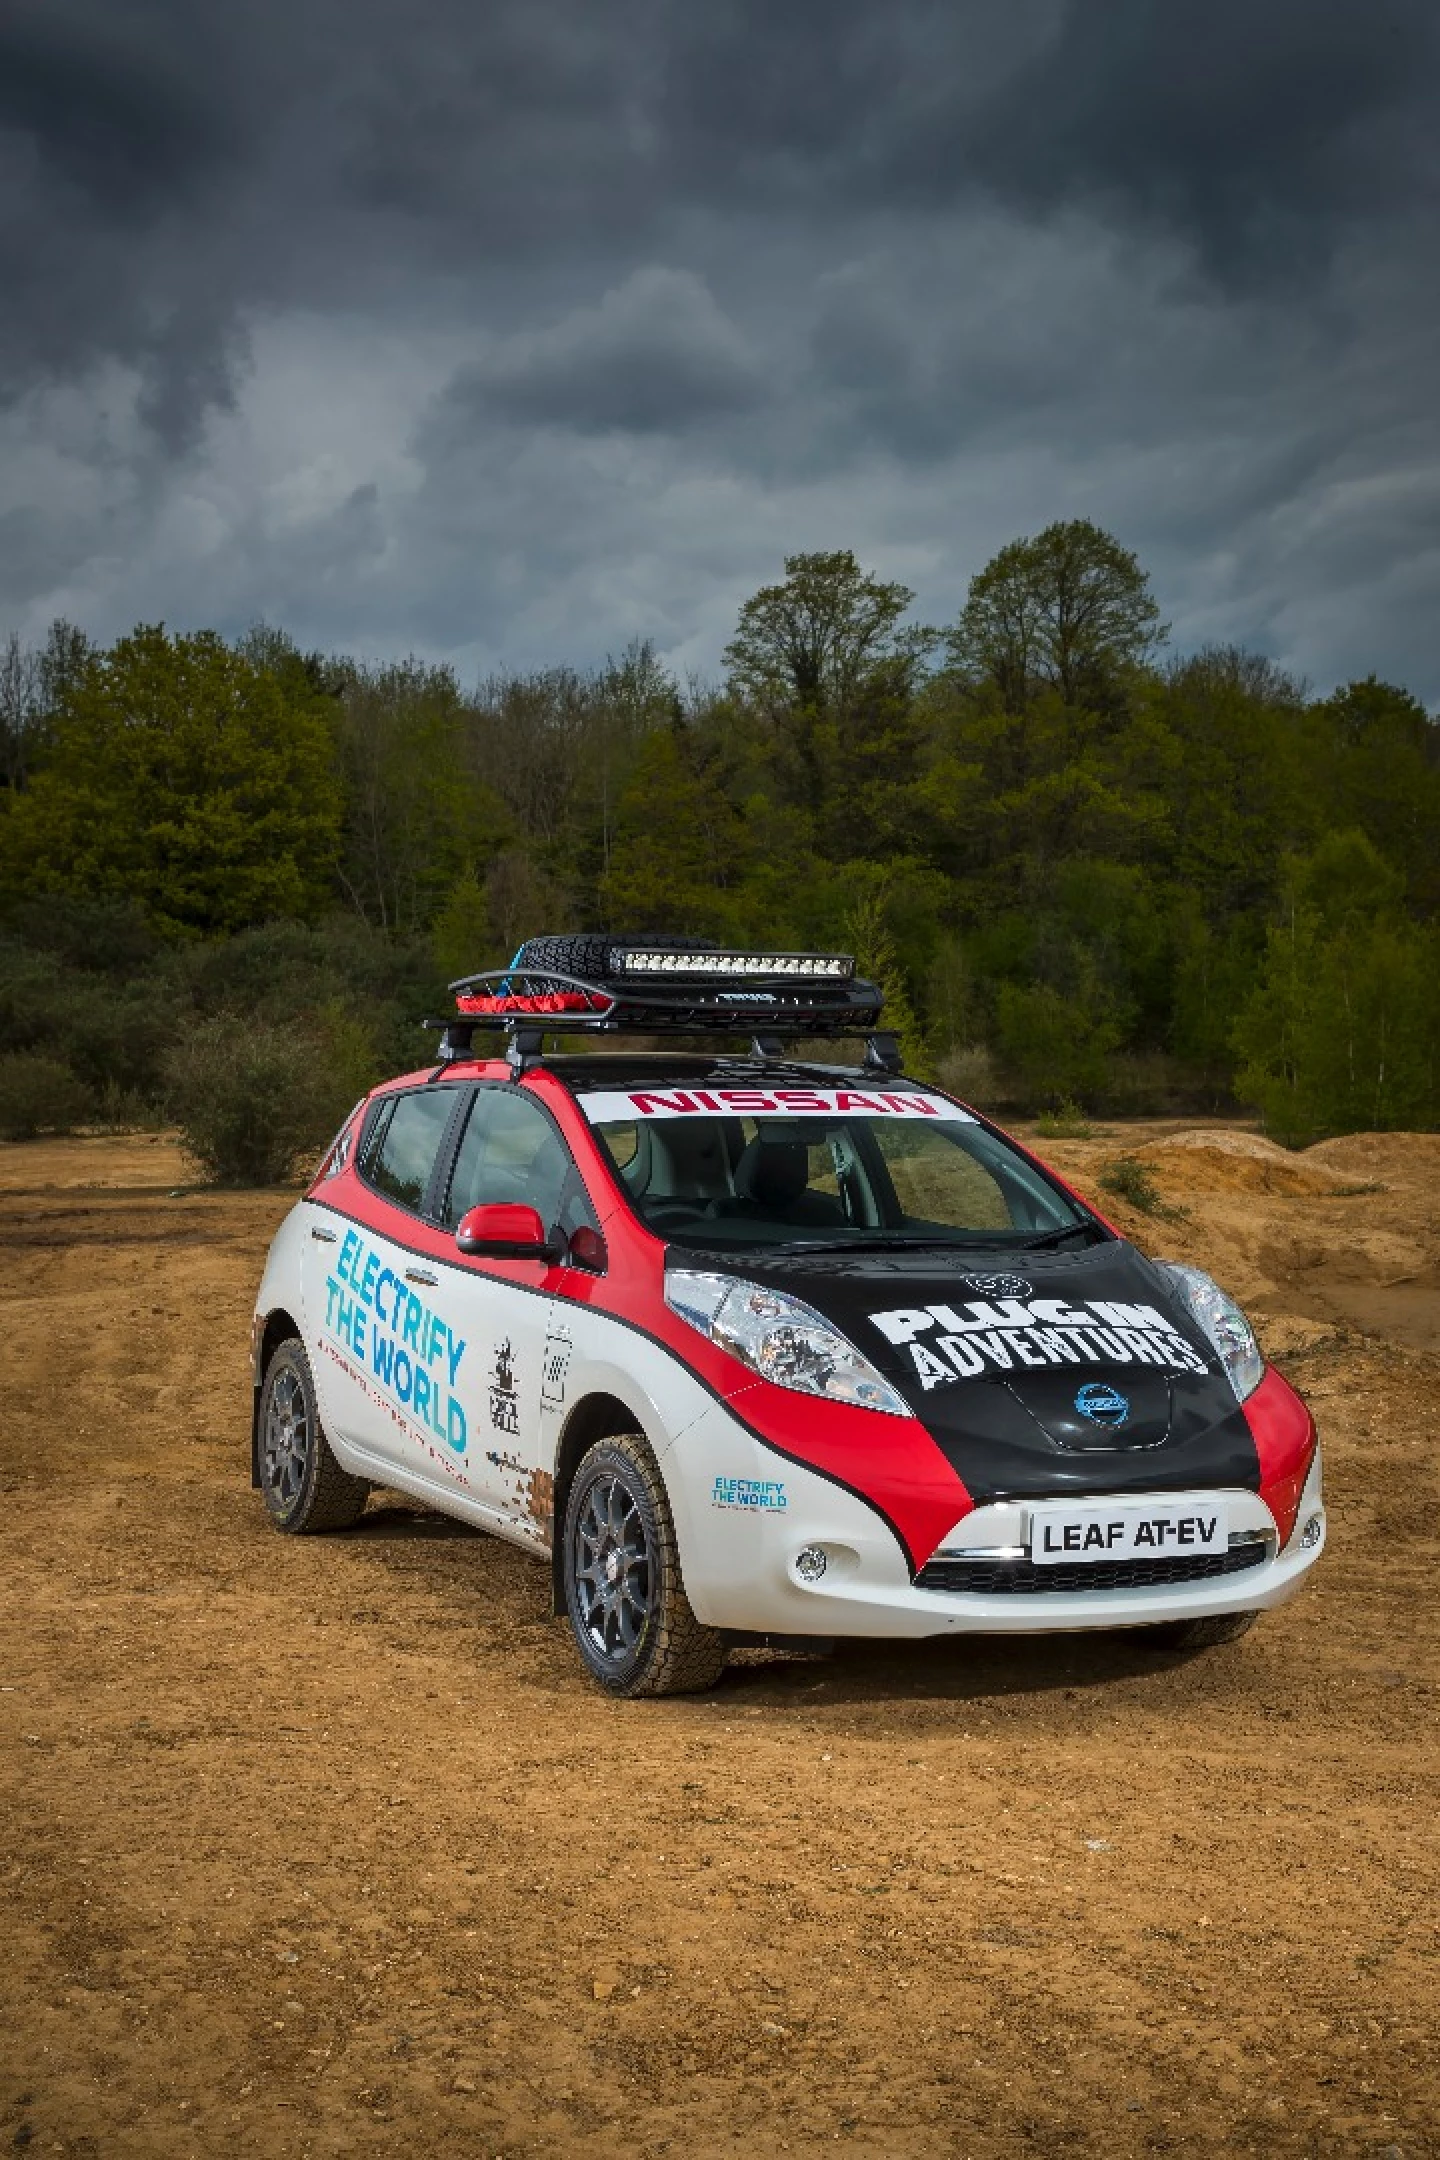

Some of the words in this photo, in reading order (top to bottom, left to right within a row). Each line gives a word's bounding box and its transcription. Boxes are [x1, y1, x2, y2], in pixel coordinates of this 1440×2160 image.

[628, 1091, 940, 1115] NISSAN
[337, 1229, 466, 1386] ELECTRIFY
[868, 1300, 1101, 1344] PLUG
[326, 1276, 366, 1360] THE
[373, 1324, 467, 1453] WORLD
[909, 1326, 1209, 1390] ADVENTURES
[712, 1489, 735, 1503] THE
[738, 1492, 787, 1507] WORLD
[715, 1477, 785, 1494] ELECTRIFY
[1044, 1522, 1125, 1553] LEAF
[1133, 1517, 1217, 1546] AT-EV
